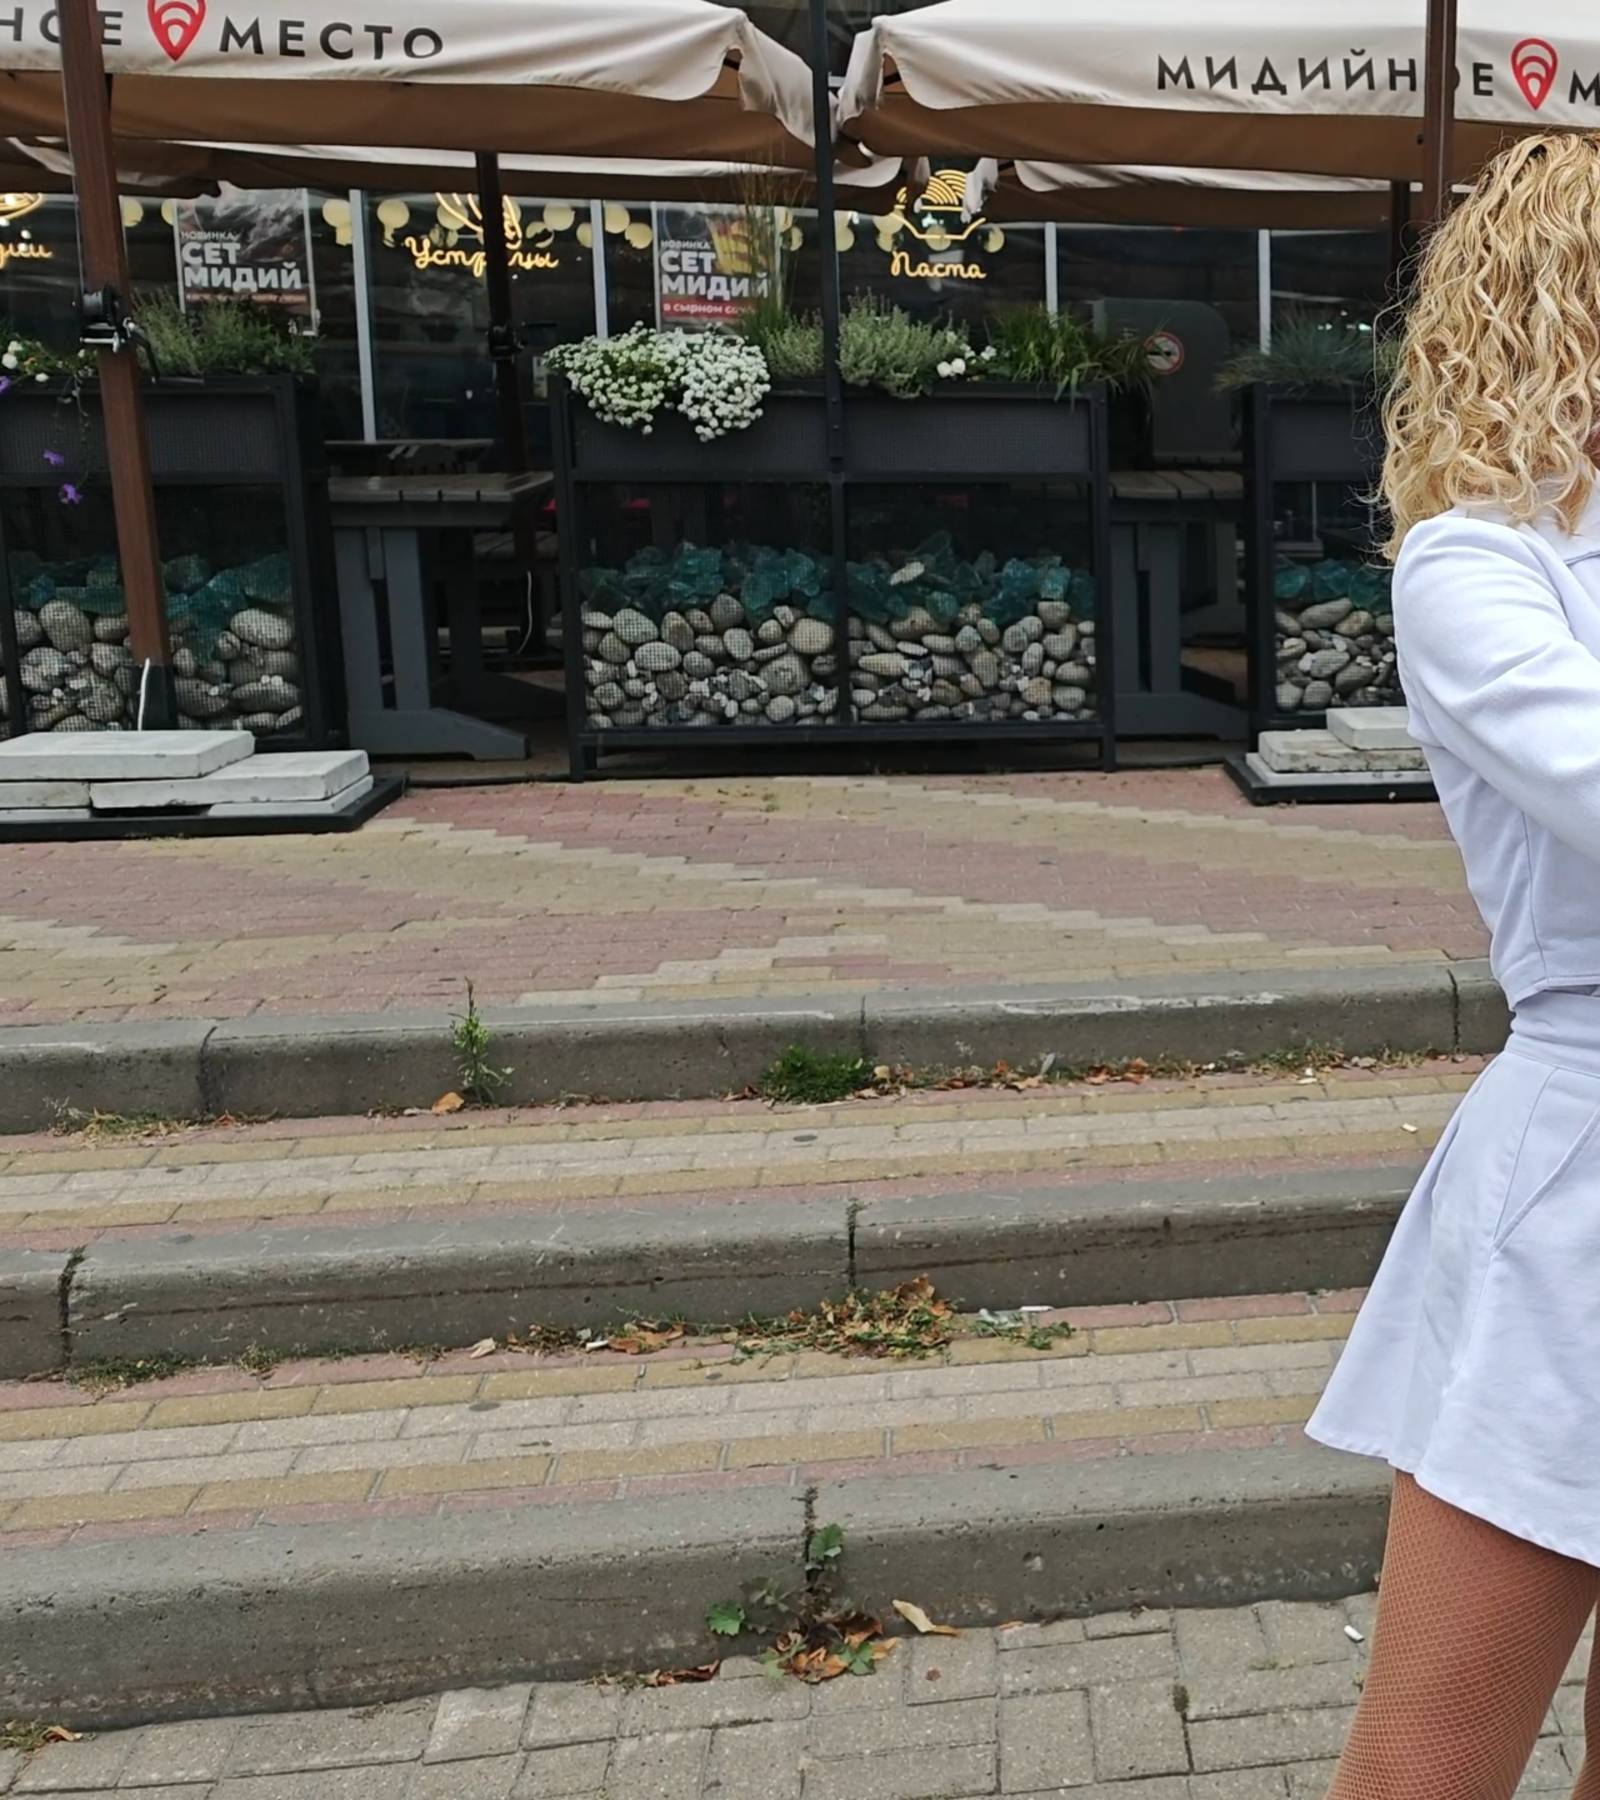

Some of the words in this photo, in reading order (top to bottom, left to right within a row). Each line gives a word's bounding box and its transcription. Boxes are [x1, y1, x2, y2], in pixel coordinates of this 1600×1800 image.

[218, 16, 444, 60] МЕСТО
[1157, 48, 1494, 97] МИДИЙНЕ
[182, 242, 241, 265] СЕТ
[661, 240, 711, 250] НОВИНКА
[660, 250, 717, 273] СЕТ
[890, 250, 987, 278] Паста
[184, 262, 301, 293] МИДИЙ
[662, 272, 769, 300] МИДИЙ
